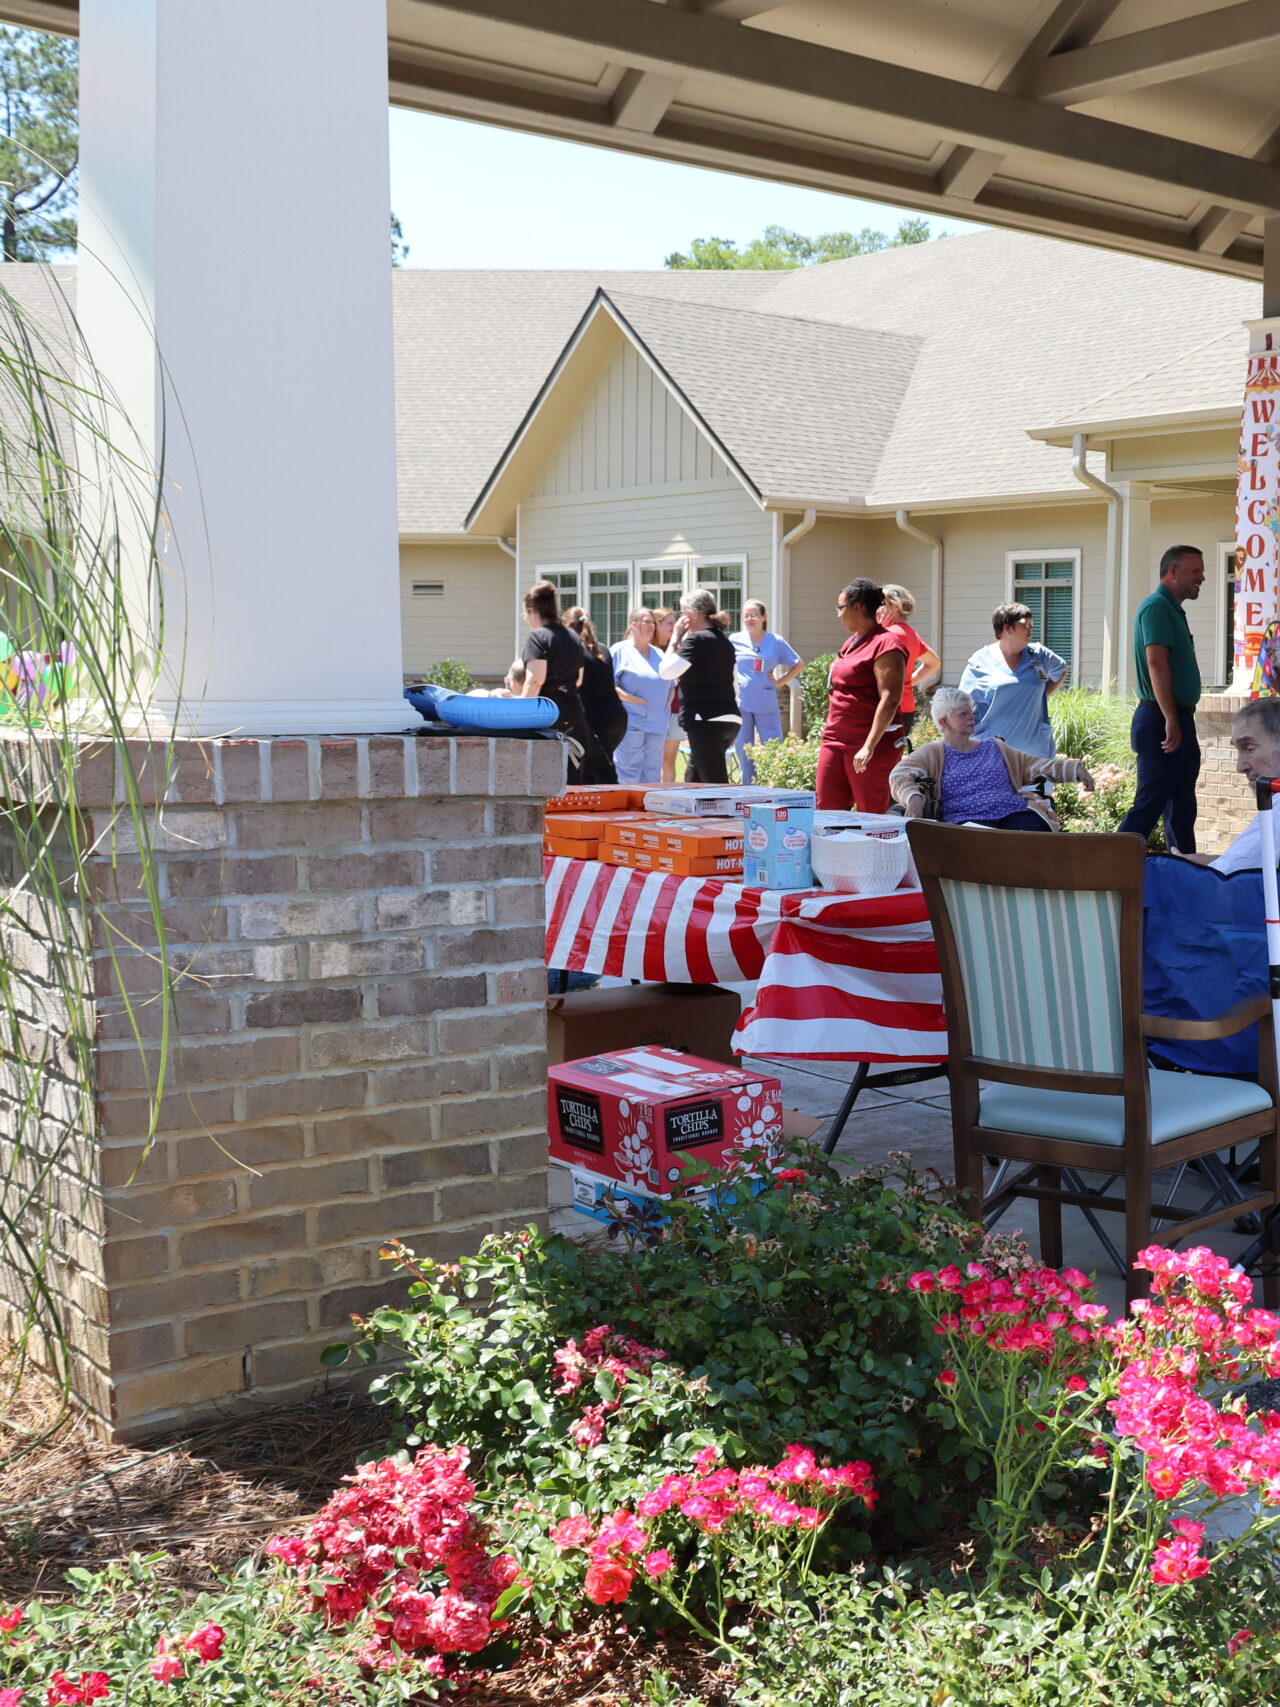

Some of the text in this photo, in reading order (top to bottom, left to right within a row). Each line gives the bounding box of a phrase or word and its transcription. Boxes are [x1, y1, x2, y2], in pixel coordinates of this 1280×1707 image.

[1244, 399, 1276, 626] WELCOME
[560, 1099, 599, 1124] TORTILLA
[670, 1108, 718, 1129] TORTILLA
[569, 1113, 592, 1132] CHIPS
[680, 1119, 709, 1135] CHIPS
